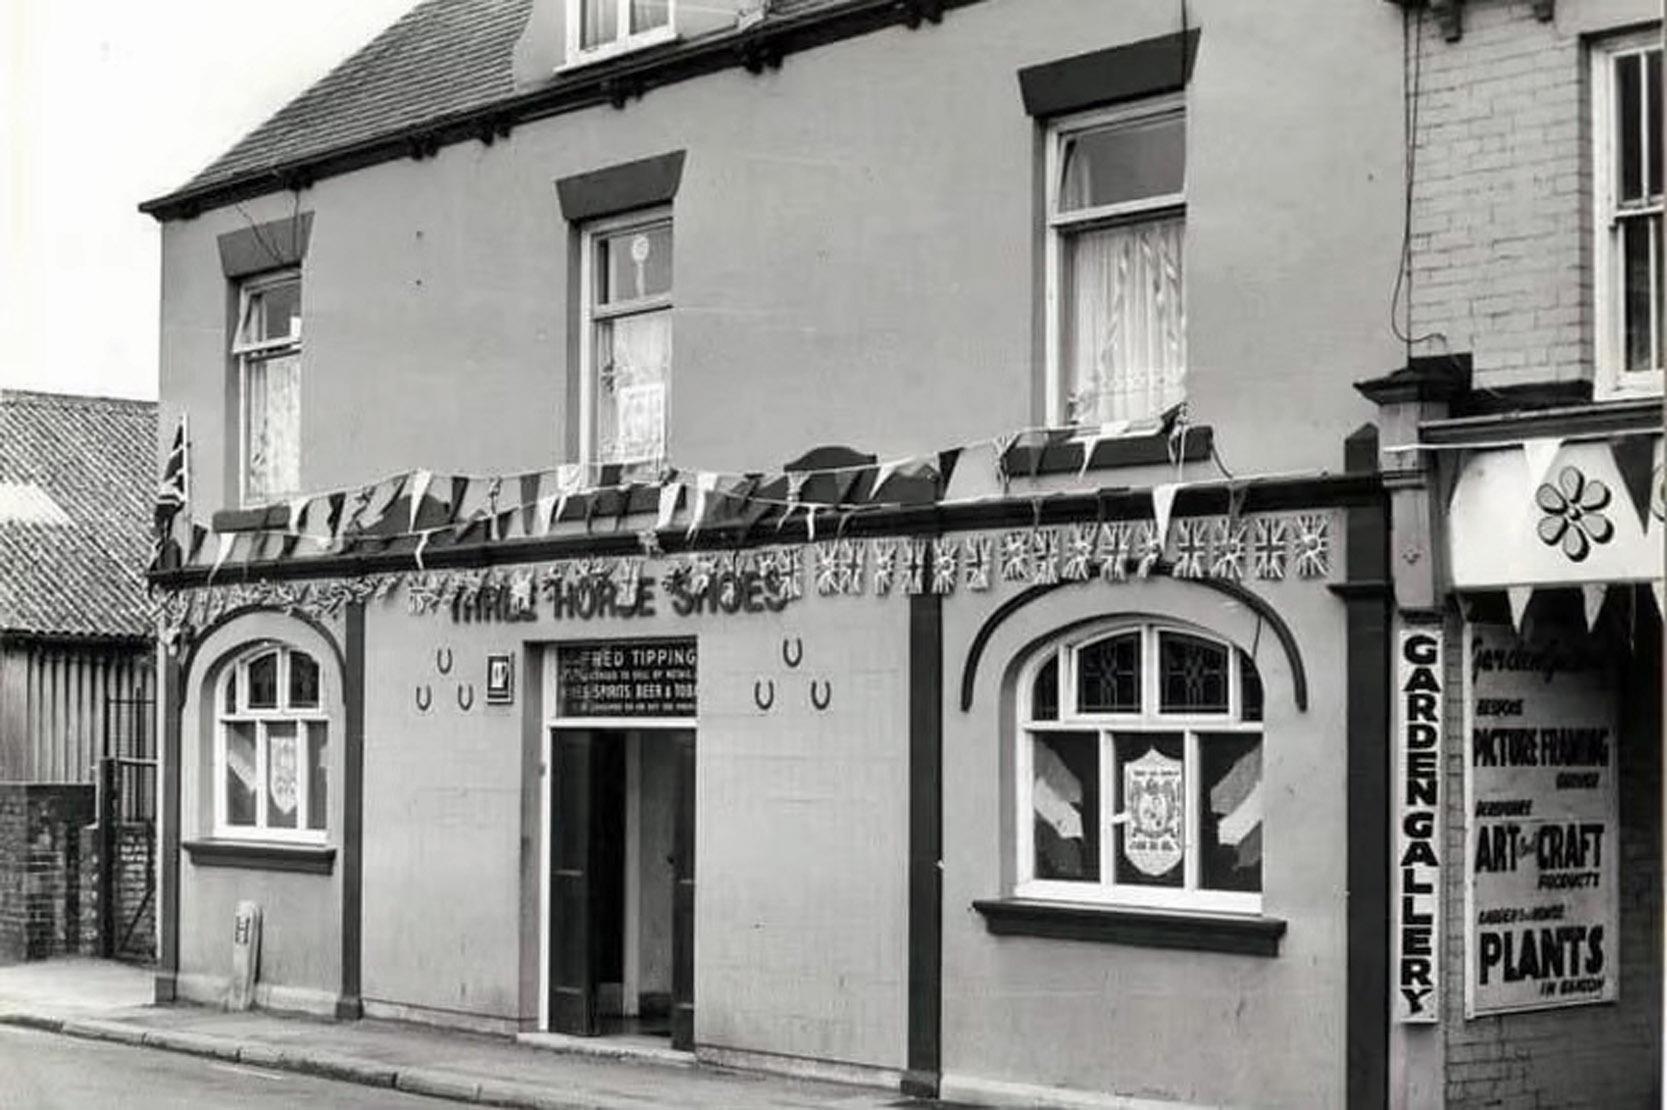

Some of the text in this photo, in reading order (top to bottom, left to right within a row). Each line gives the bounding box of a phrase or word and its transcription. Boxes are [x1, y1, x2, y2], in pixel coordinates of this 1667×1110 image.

[631, 648, 697, 667] TIPPING
[1402, 633, 1442, 807] GARDEN
[1473, 728, 1539, 767] PICTURE
[1474, 824, 1521, 873] ART
[1537, 824, 1605, 870] CRAFT
[1400, 811, 1440, 1014] GALLERY
[1479, 924, 1605, 986] PLANTS
